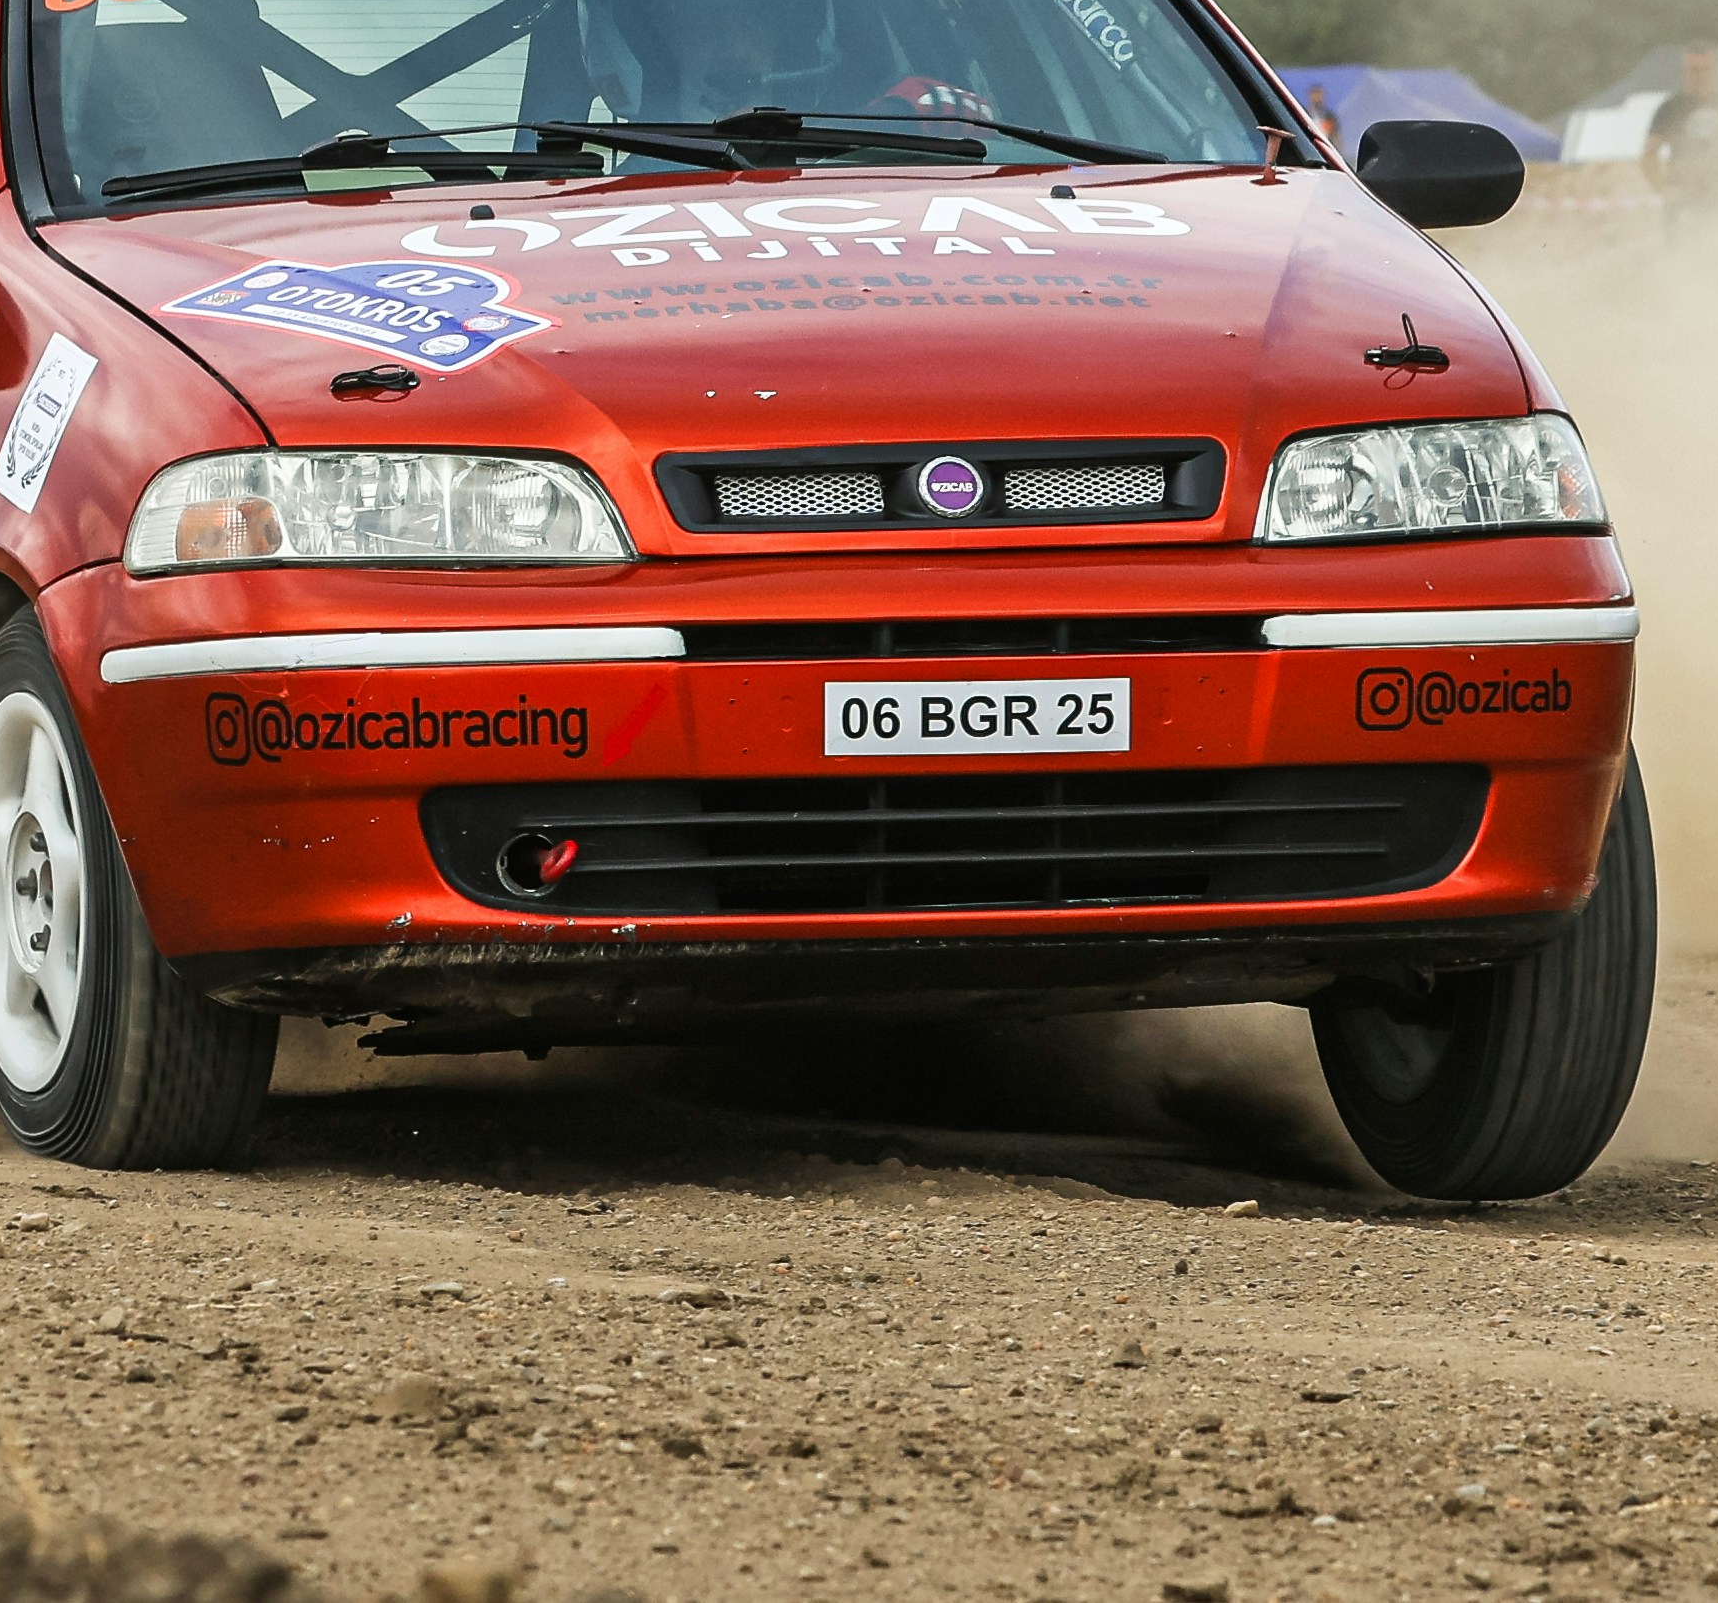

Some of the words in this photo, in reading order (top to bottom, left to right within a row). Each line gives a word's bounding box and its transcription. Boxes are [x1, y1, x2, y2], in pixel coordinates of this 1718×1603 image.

[400, 196, 1192, 258] OZICAB
[266, 285, 455, 333] OTOKROS
[374, 269, 477, 297] 05
[841, 697, 901, 740] 06
[920, 694, 1041, 738] BGR
[1055, 692, 1115, 735] 25
[1416, 667, 1572, 726] @ozicab
[252, 694, 588, 763] @ozicabracing
